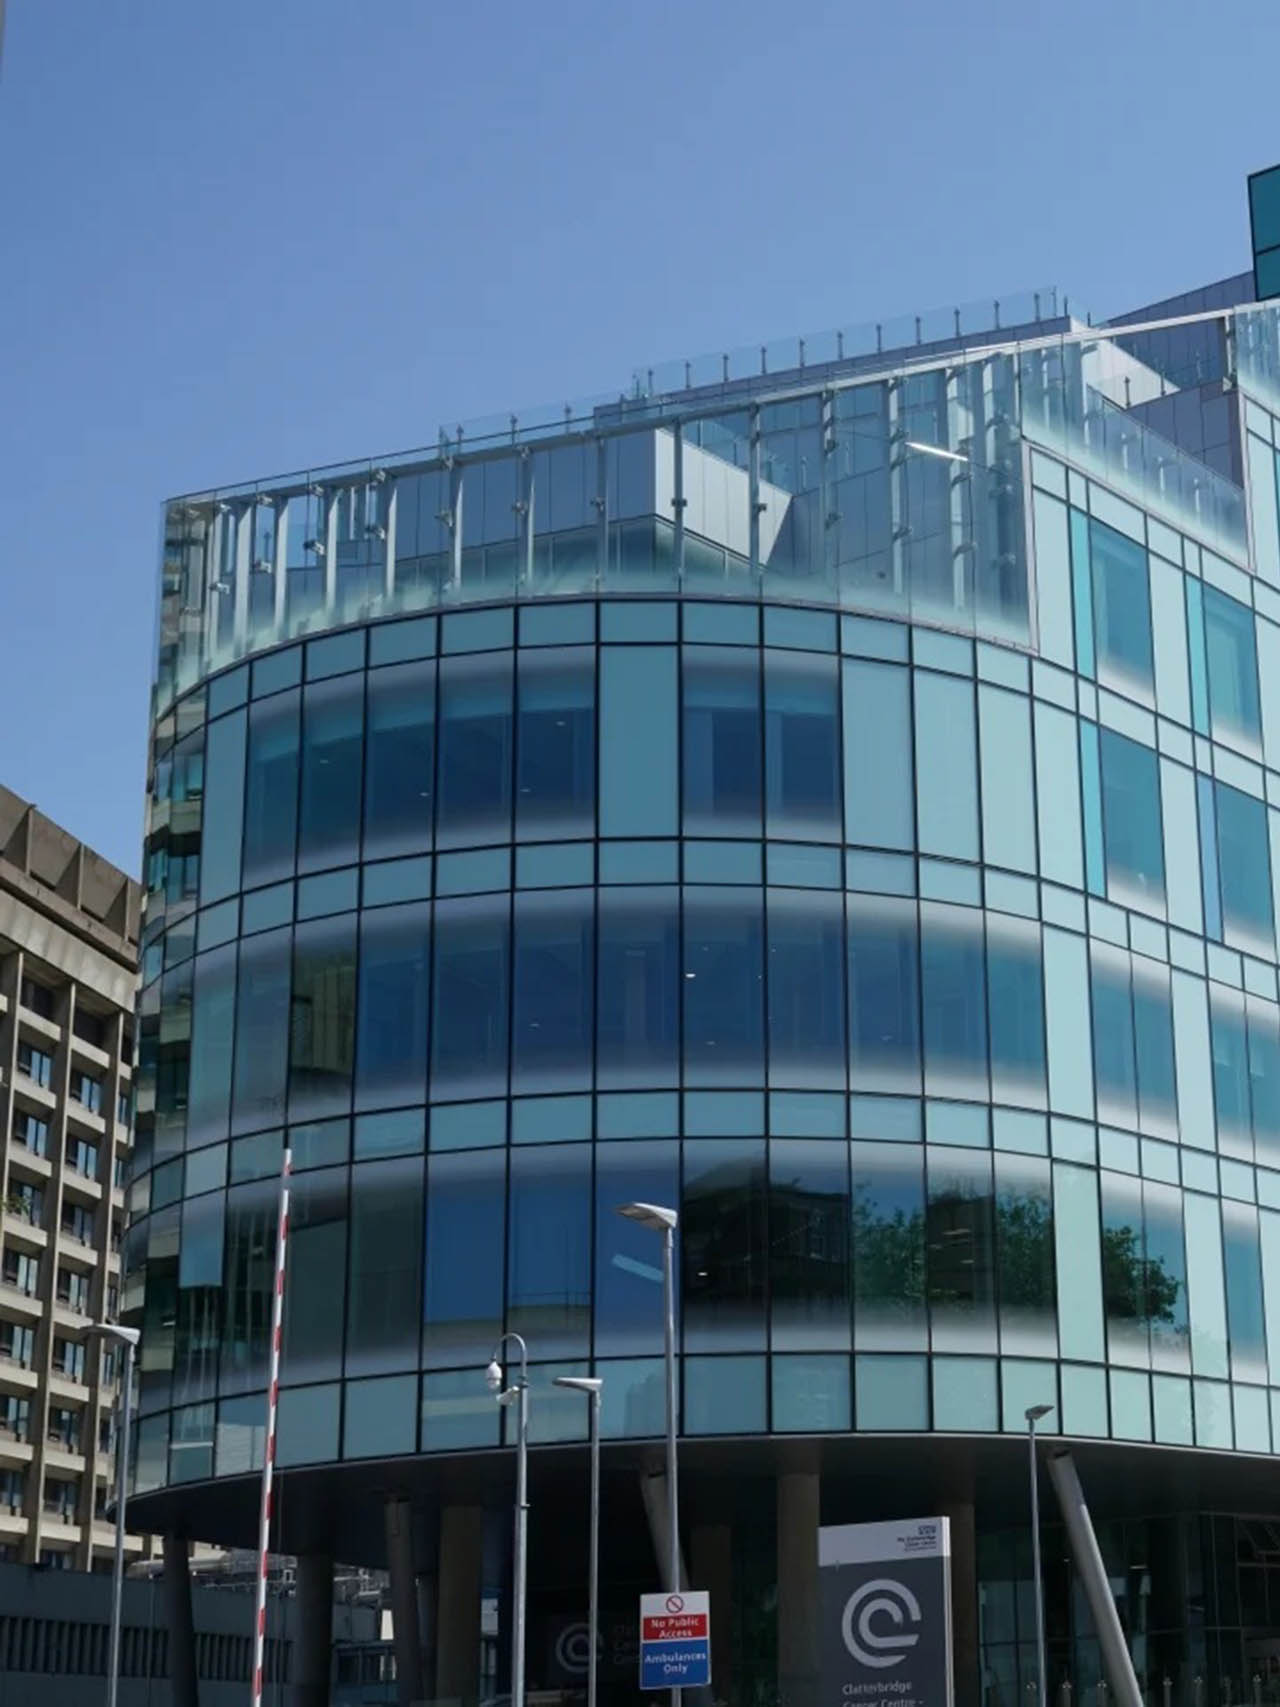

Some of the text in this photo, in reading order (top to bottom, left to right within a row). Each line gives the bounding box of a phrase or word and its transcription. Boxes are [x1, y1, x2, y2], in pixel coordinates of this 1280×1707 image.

[651, 1616, 700, 1629] No Public
[658, 1629, 693, 1638] Access
[644, 1651, 706, 1663] Ambulances
[663, 1663, 688, 1675] Only
